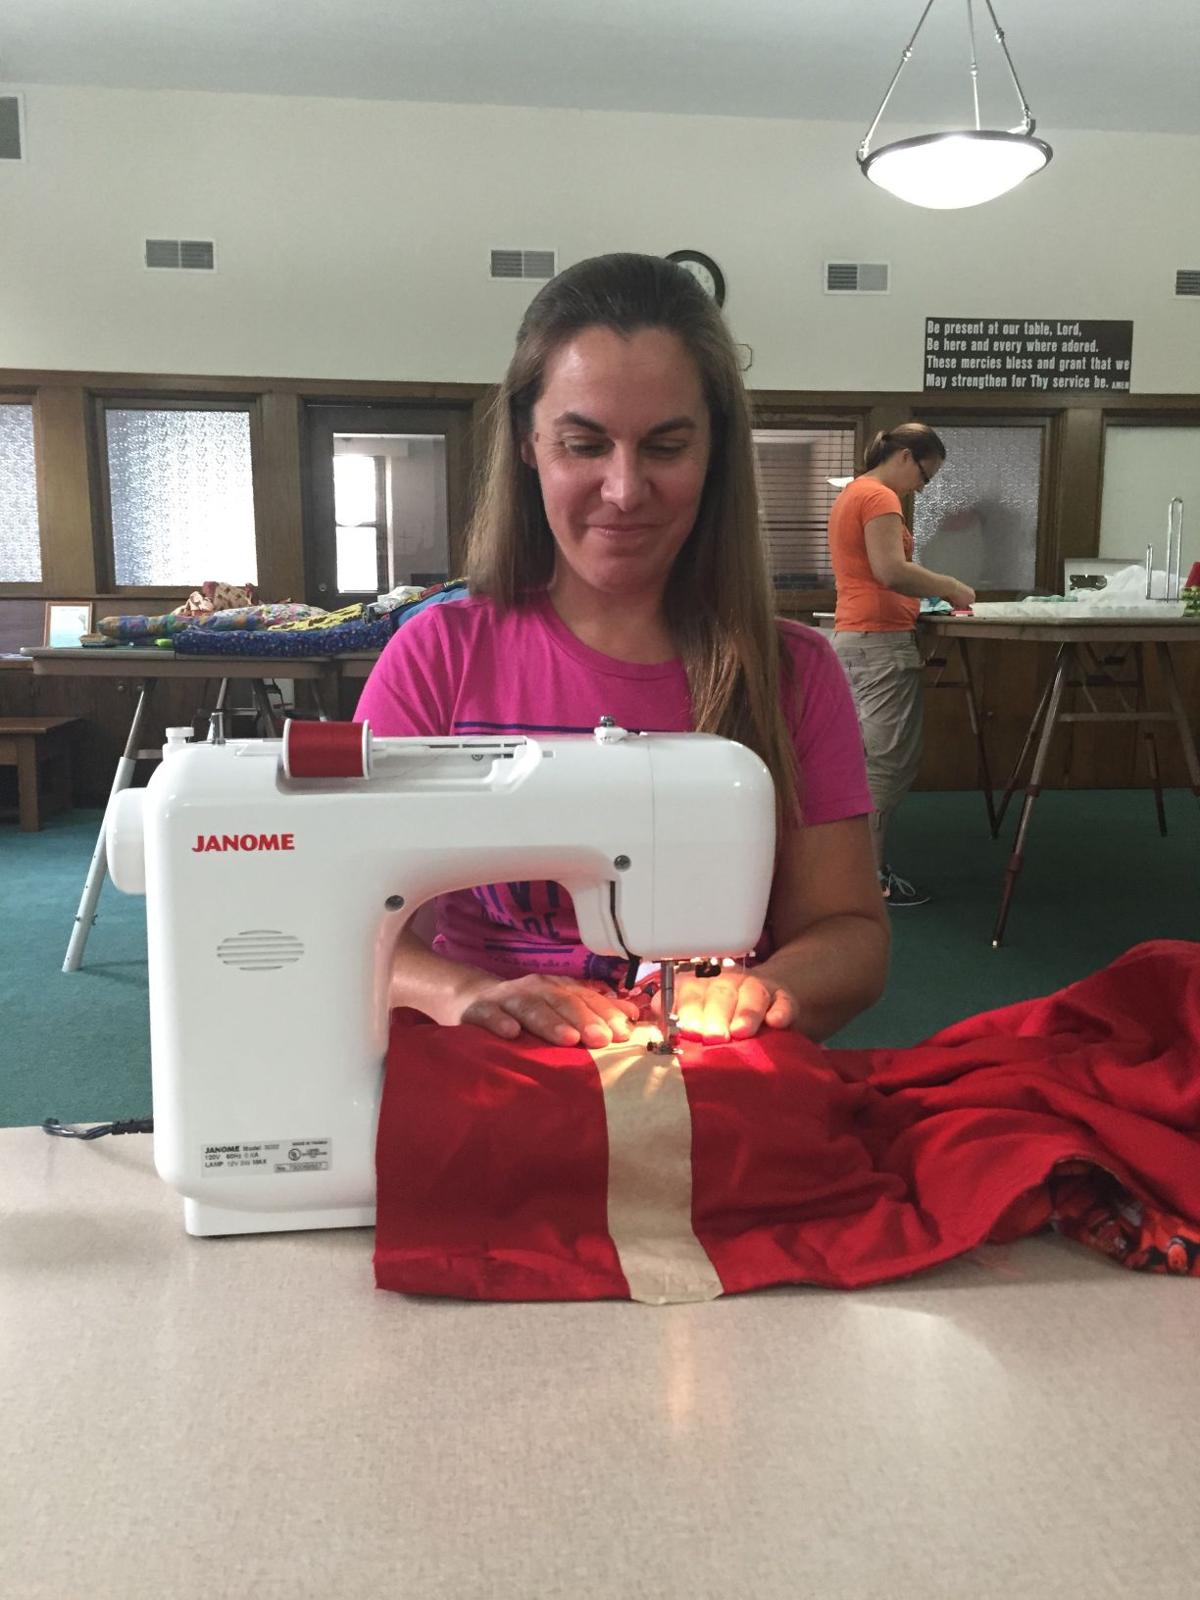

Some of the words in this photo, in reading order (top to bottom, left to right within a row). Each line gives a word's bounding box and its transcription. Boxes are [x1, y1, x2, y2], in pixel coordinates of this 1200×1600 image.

[927, 321, 939, 334] Be
[944, 321, 984, 336] present
[988, 322, 998, 334] at
[1003, 324, 1020, 335] our
[1024, 322, 1053, 336] table,
[1057, 323, 1082, 337] Lord,
[927, 338, 939, 350] Be
[944, 338, 967, 351] here
[971, 339, 989, 351] and
[994, 341, 1022, 353] every
[1026, 340, 1057, 352] where
[1062, 340, 1099, 352] adored.
[927, 355, 957, 369] These
[961, 356, 1002, 369] mercies
[1006, 356, 1033, 369] bless
[1037, 357, 1055, 369] and
[1059, 357, 1086, 371] grant
[1091, 357, 1111, 370] that
[1116, 360, 1130, 370] we
[926, 374, 947, 388] May
[951, 374, 1007, 389] strengthen
[1012, 375, 1026, 387] for
[1030, 375, 1048, 389] Thy
[1053, 375, 1090, 388] service
[1094, 376, 1108, 388] be.
[191, 833, 295, 852] JANOME
